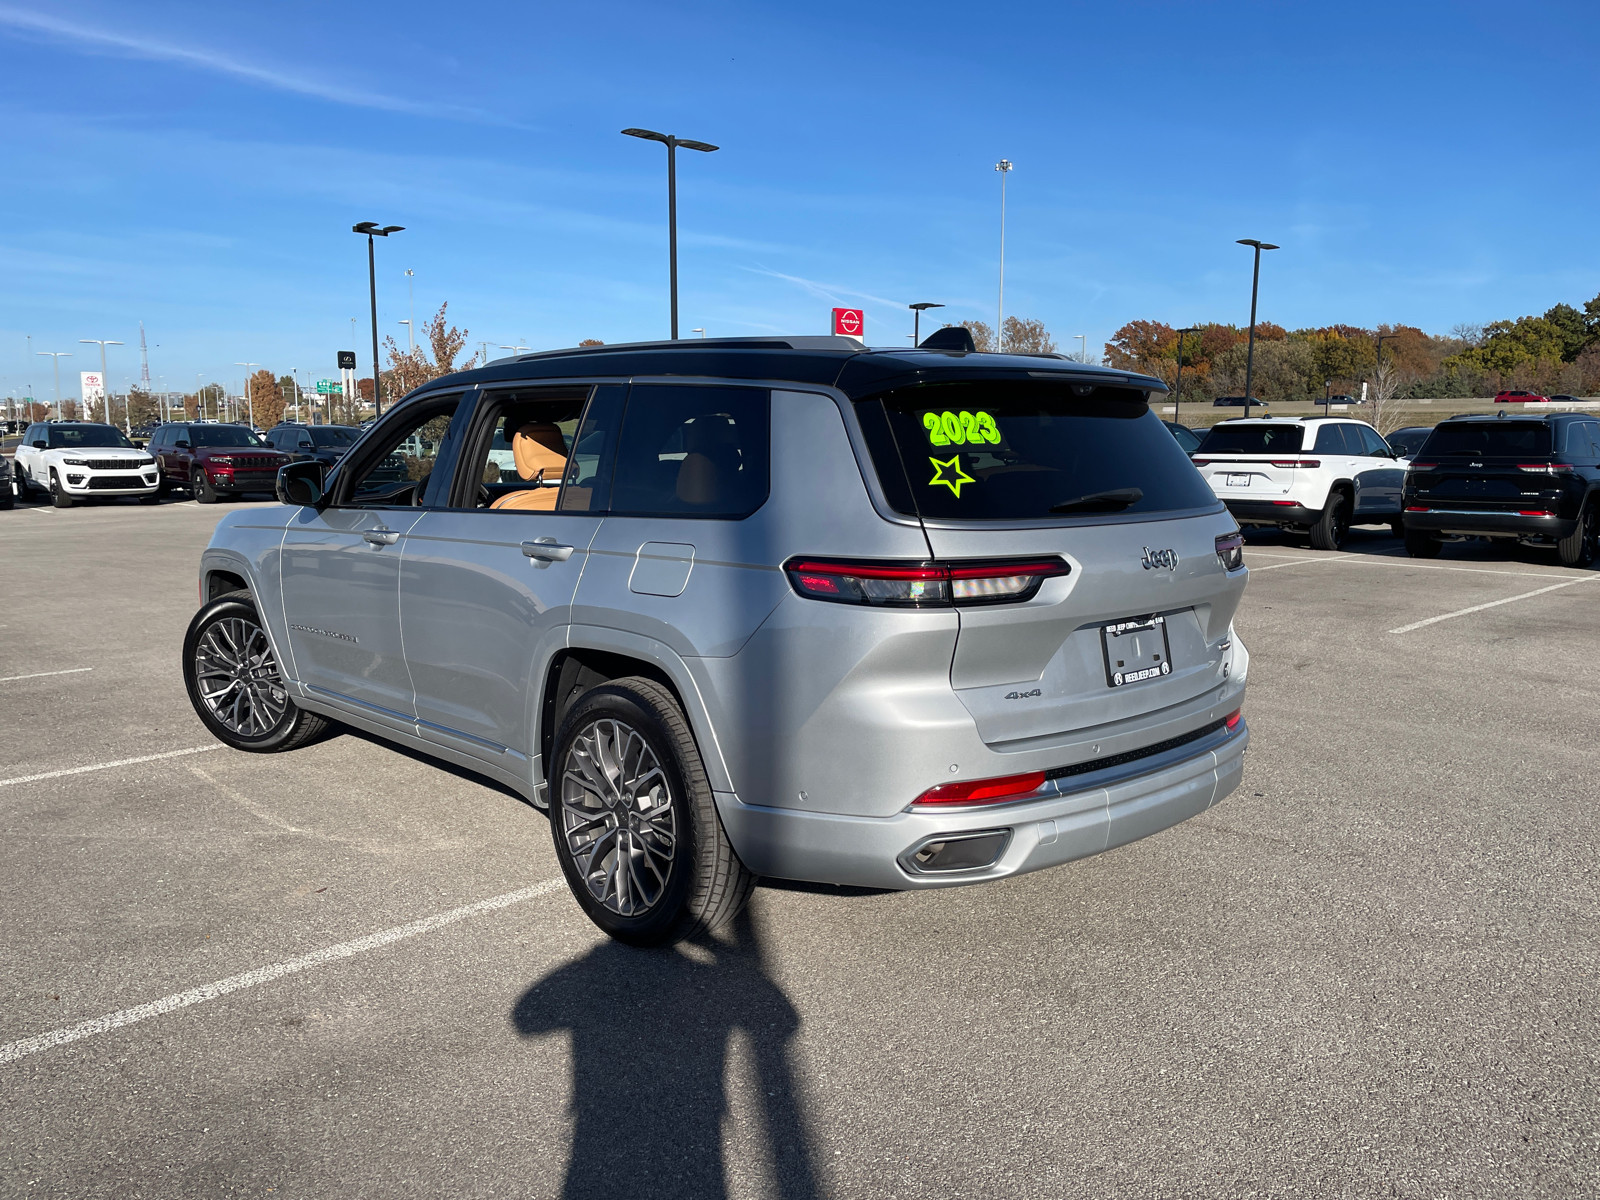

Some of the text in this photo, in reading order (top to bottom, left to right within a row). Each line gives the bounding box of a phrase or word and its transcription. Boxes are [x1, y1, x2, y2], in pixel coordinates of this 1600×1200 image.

[923, 411, 1001, 446] 2023
[1141, 546, 1179, 571] Jeep
[1125, 667, 1160, 683] REEDJEEP.COM
[1004, 688, 1042, 699] 4x4
